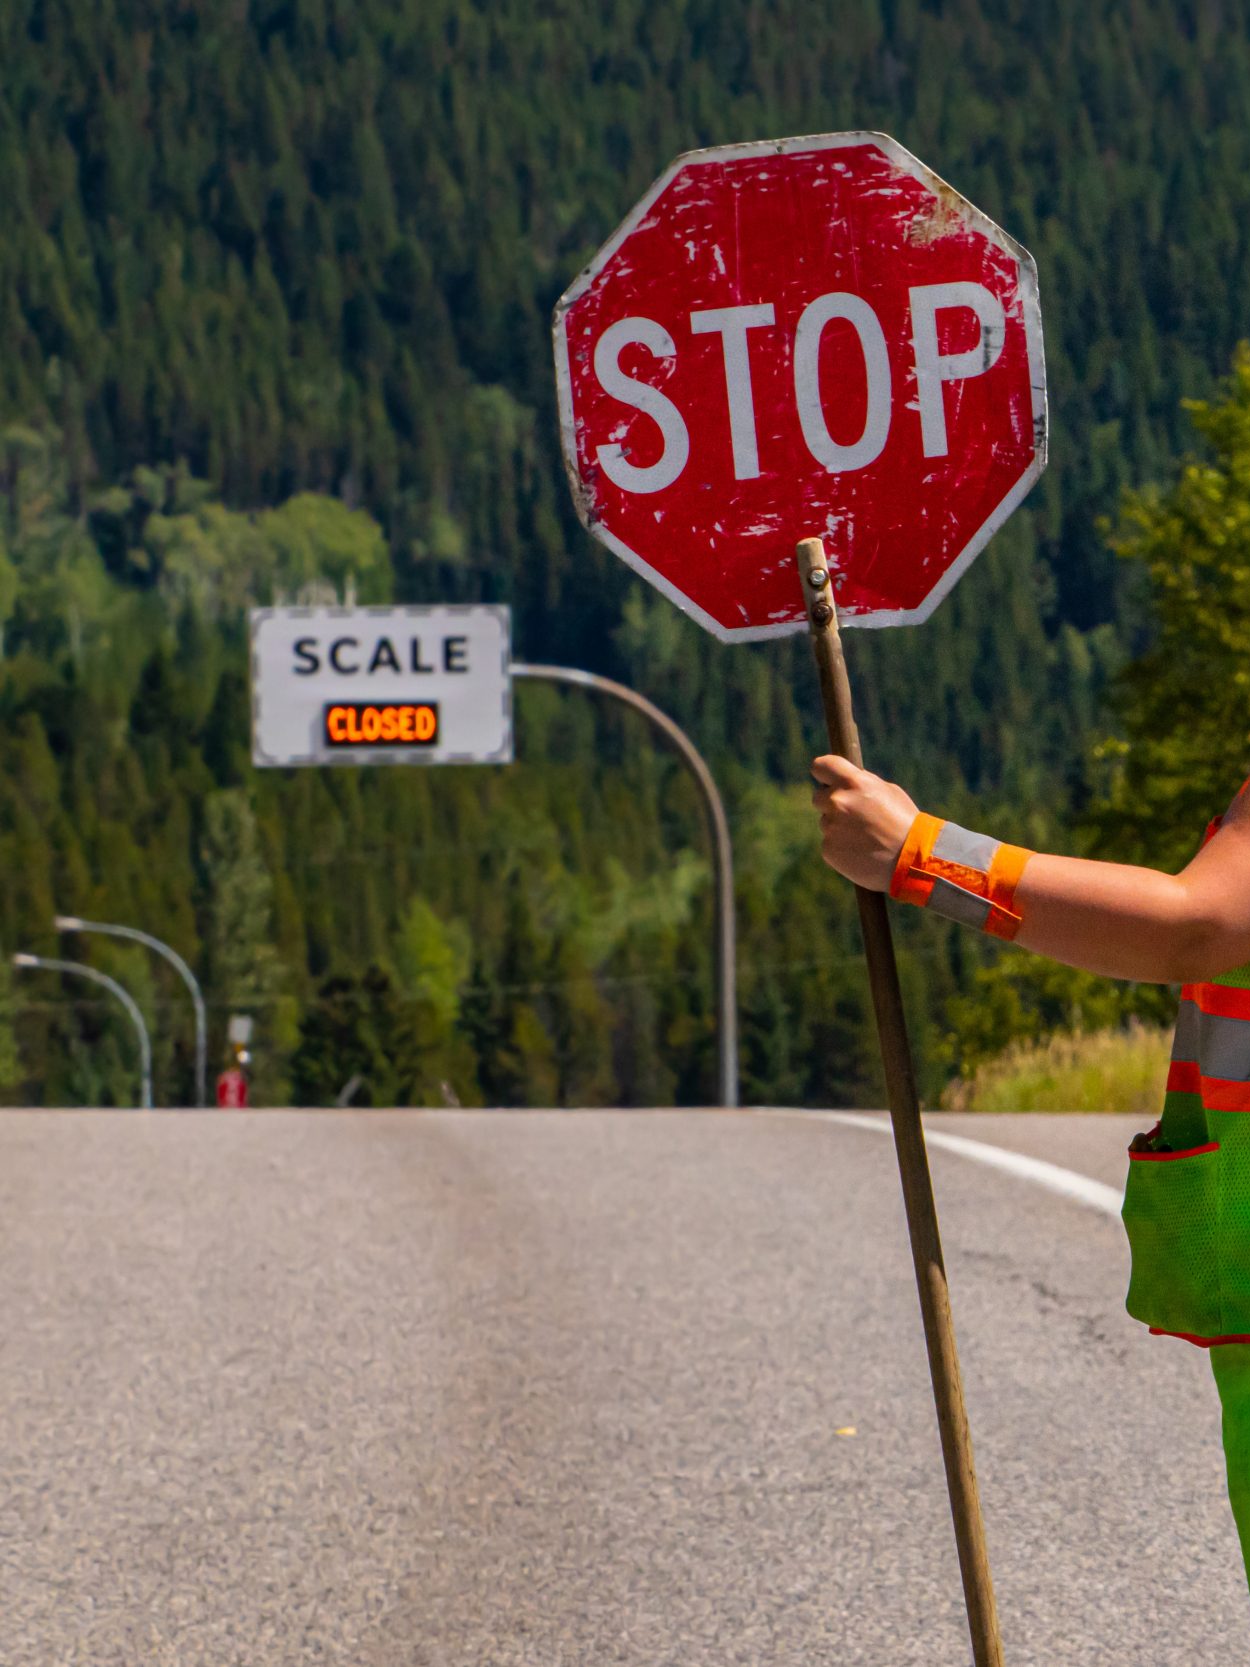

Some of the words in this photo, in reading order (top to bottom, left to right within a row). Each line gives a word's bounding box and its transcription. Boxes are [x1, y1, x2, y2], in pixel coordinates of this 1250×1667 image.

[594, 281, 1005, 494] STOP
[293, 636, 469, 675] SCALE
[327, 706, 436, 741] CLOSED
